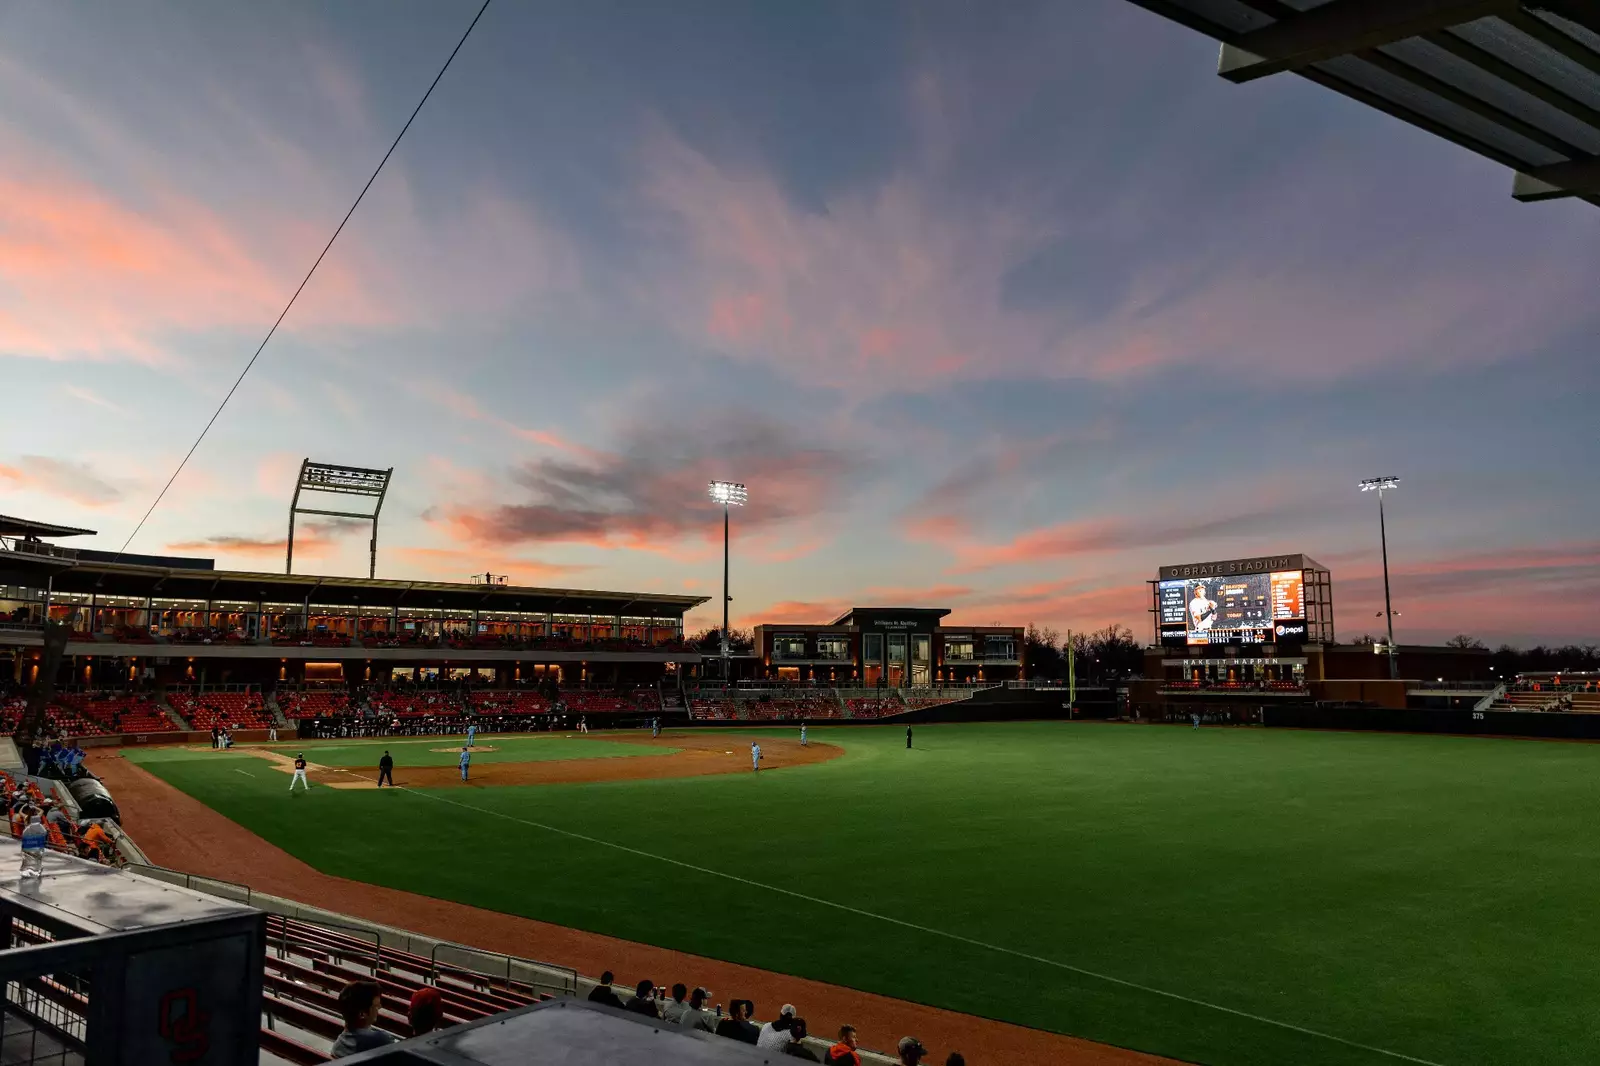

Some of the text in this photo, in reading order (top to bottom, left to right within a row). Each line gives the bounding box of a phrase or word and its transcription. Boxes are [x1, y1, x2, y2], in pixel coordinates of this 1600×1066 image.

[1171, 559, 1288, 577] O'BRATE STADIUM
[1285, 626, 1304, 634] pepsi
[1472, 712, 1484, 720] 375
